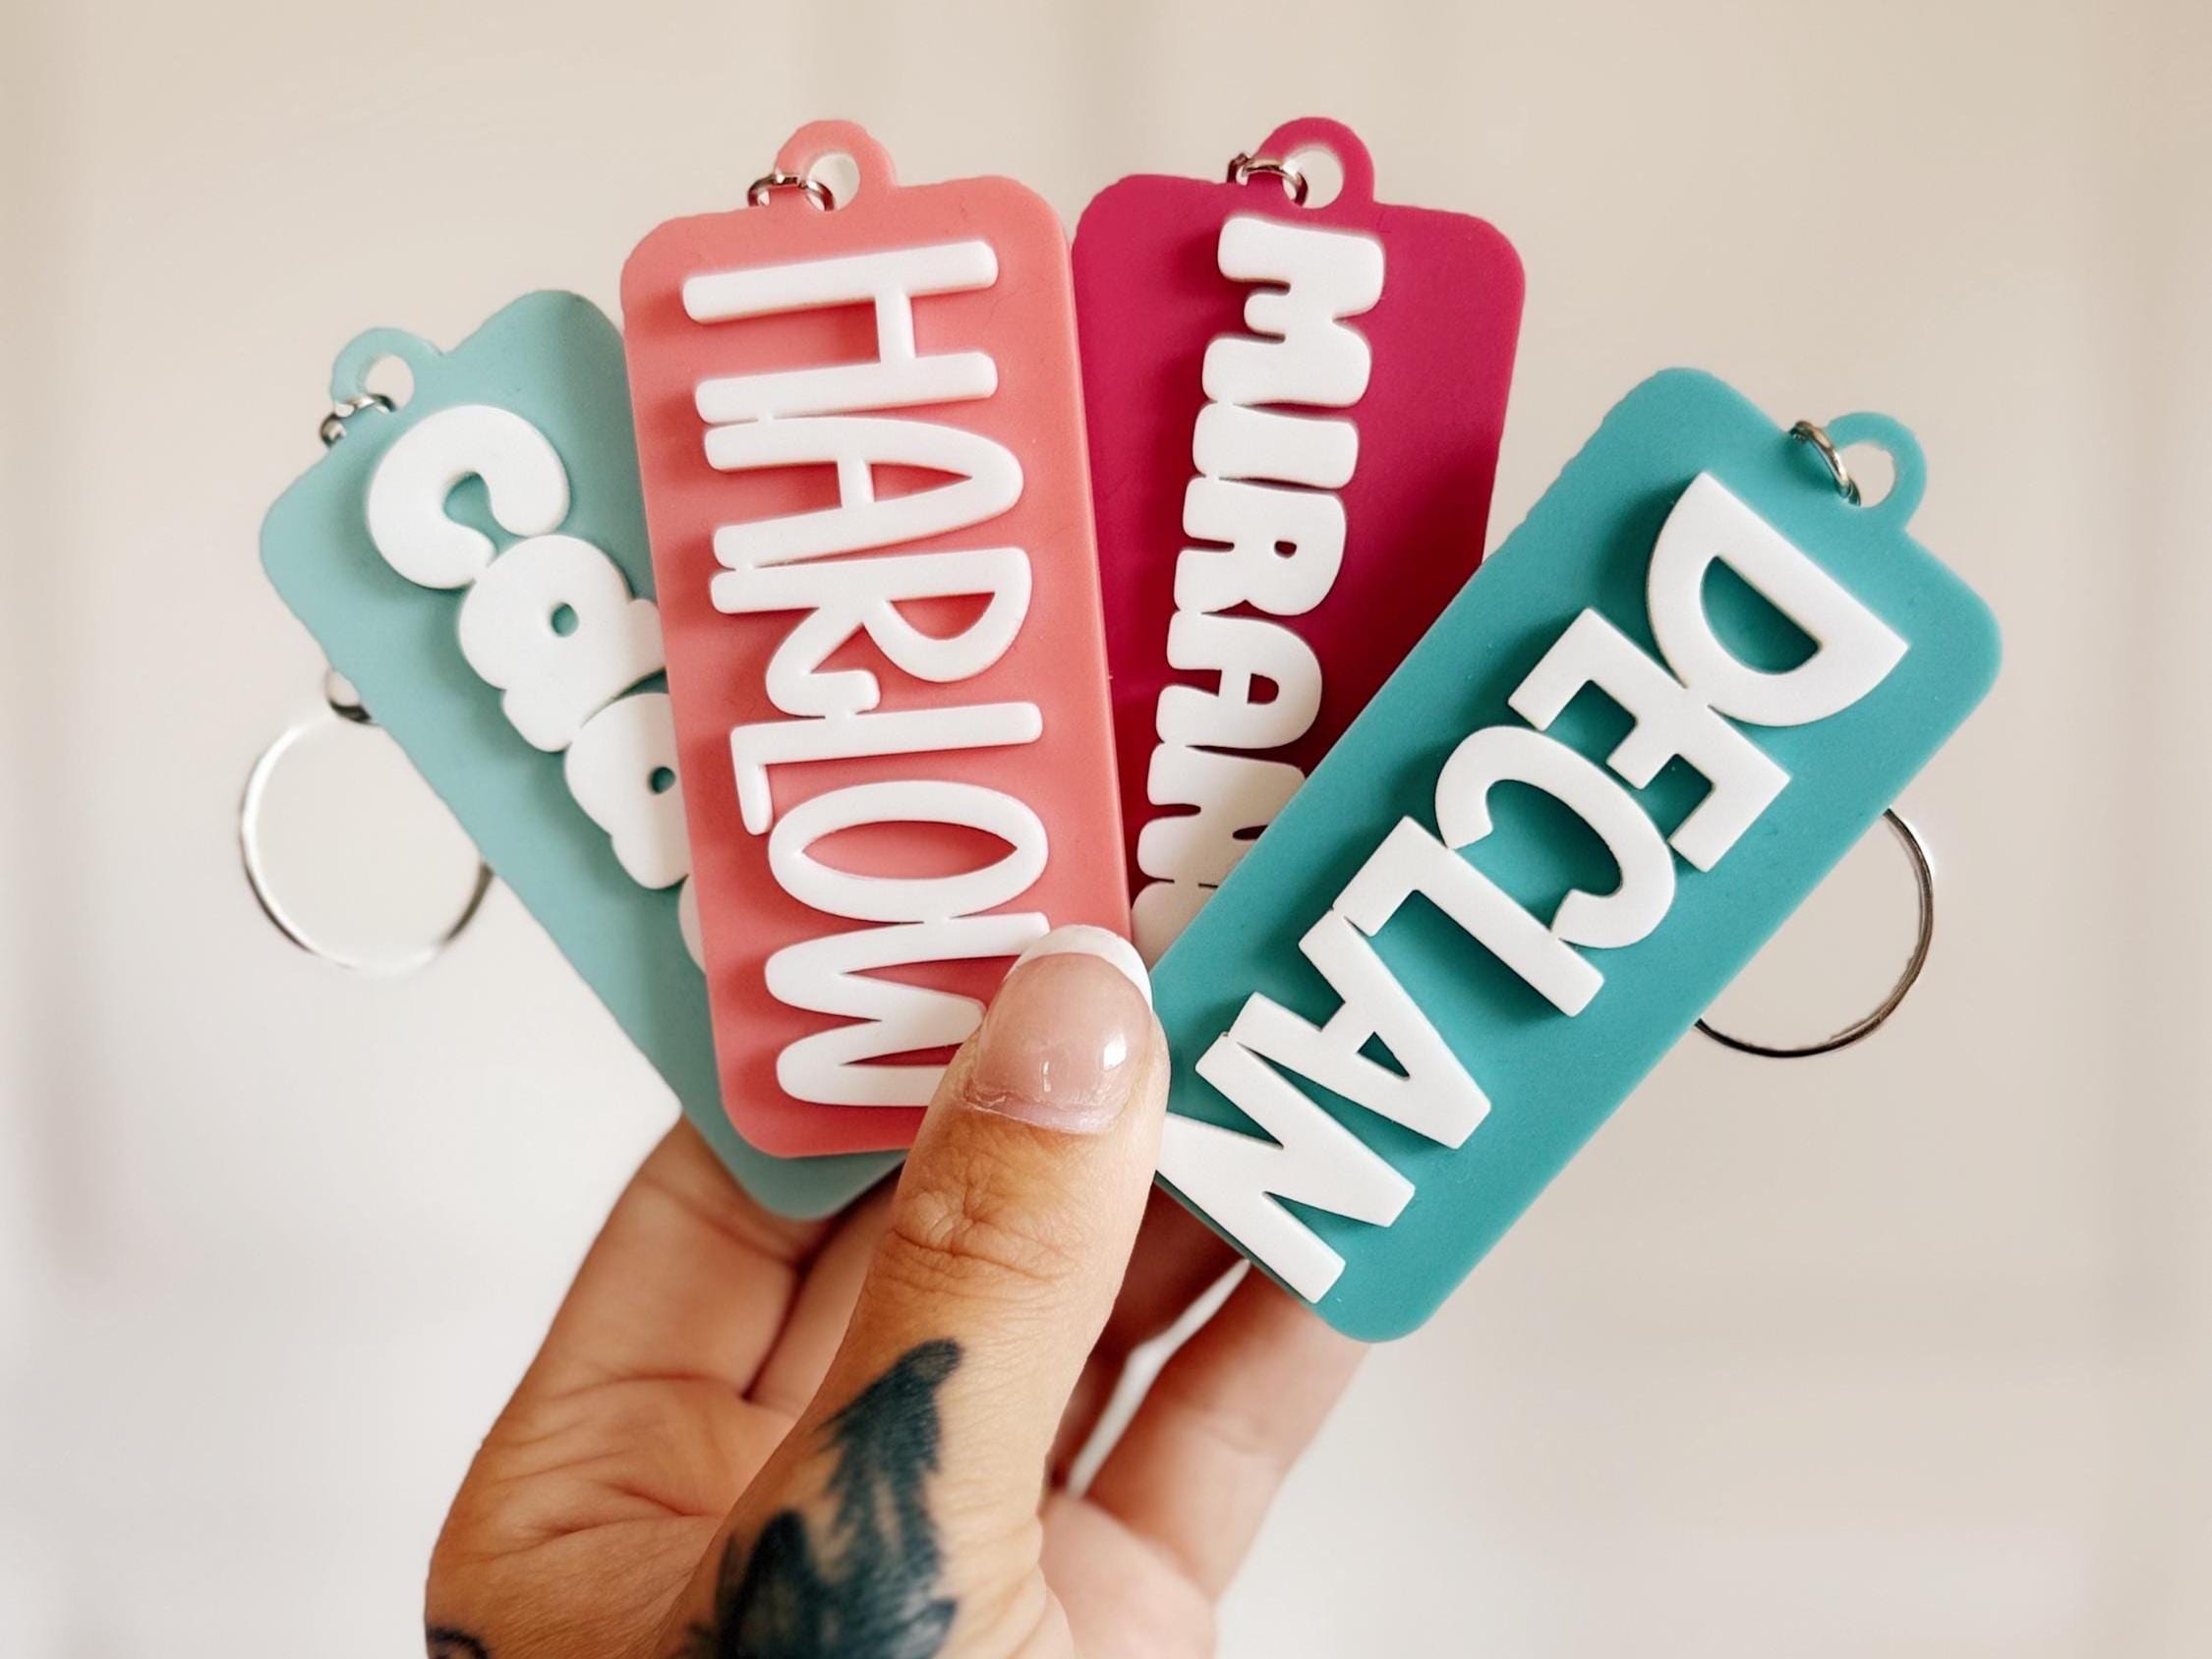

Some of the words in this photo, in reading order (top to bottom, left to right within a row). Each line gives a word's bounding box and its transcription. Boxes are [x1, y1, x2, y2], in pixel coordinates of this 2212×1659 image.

[682, 240, 1049, 1108] HARLOW
[1132, 215, 1385, 969] MIRAN
[1157, 472, 1909, 1304] DECLAN
